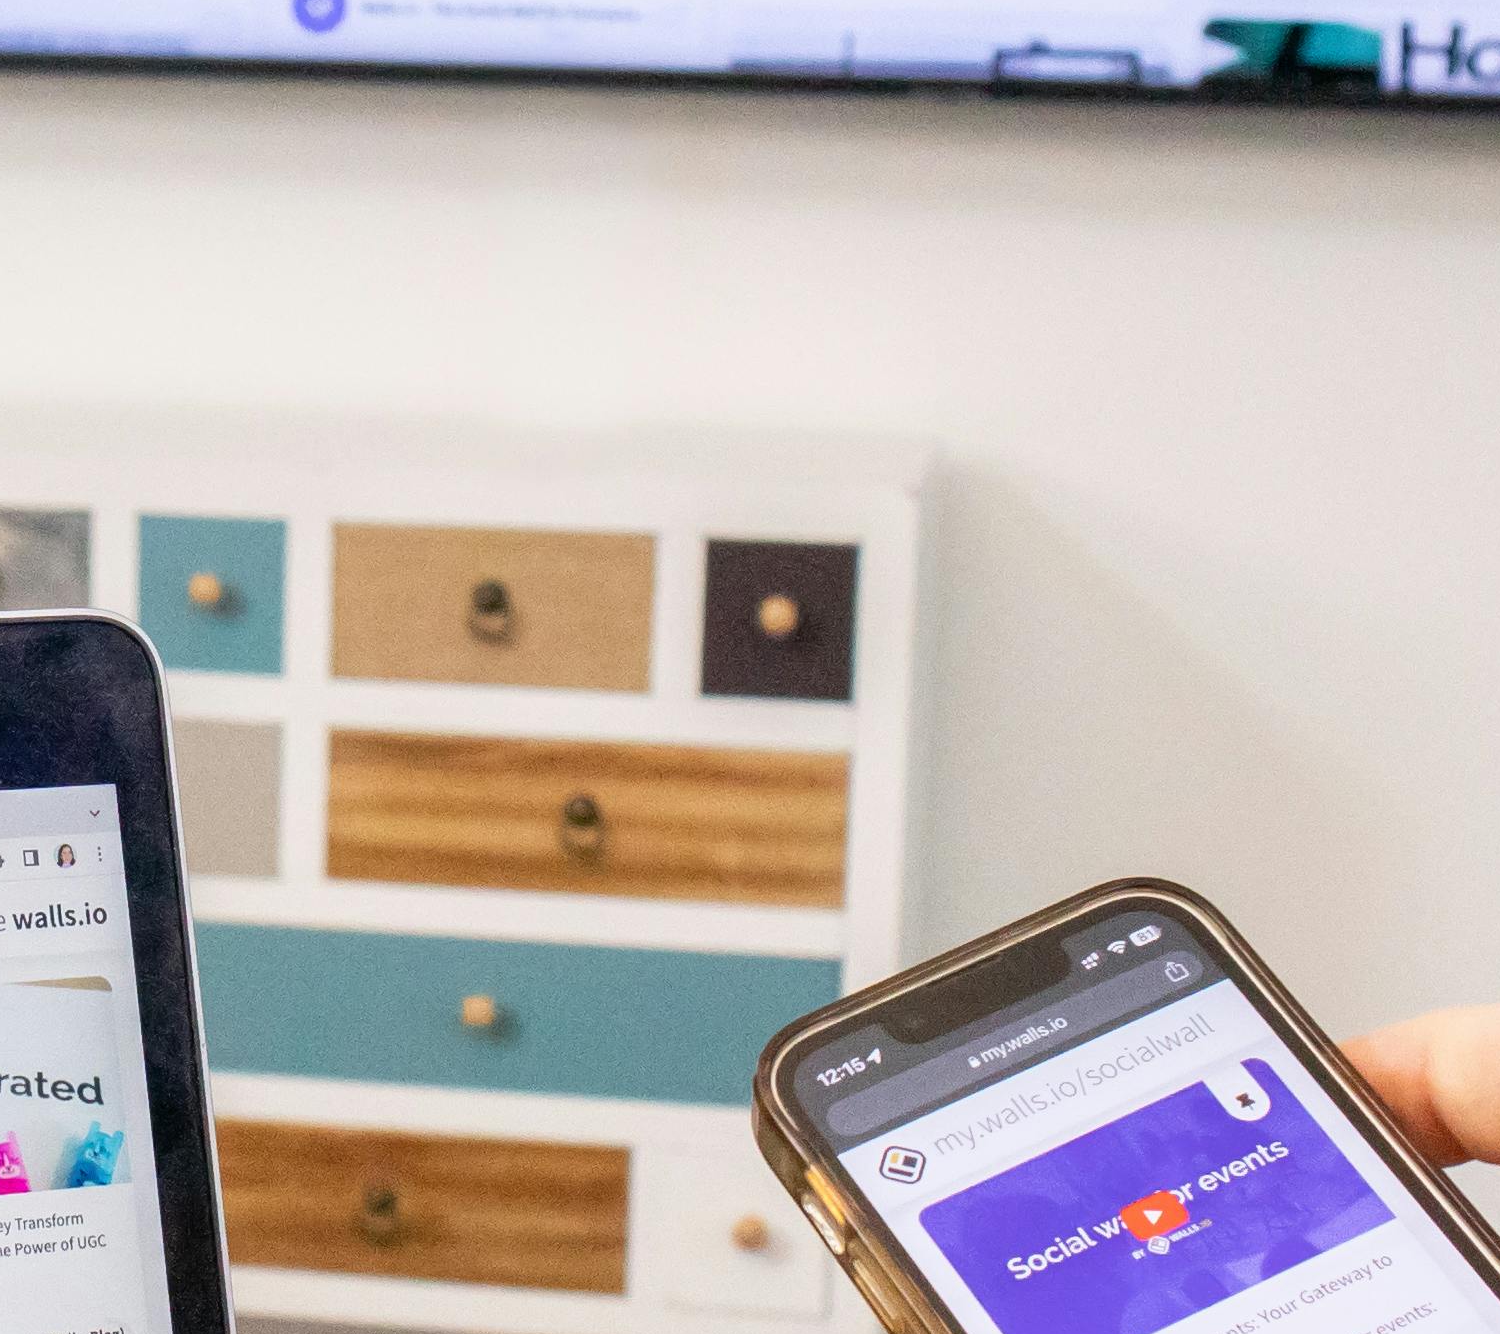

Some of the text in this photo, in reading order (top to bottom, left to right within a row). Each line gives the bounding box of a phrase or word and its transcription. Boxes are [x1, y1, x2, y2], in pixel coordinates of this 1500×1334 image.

[11, 901, 108, 931] walls.io
[980, 1017, 1069, 1065] my.walls.io
[816, 1058, 866, 1087] 12:15
[933, 1012, 1216, 1156] my.walls.io/socialwall
[1007, 1226, 1098, 1280] Social
[1198, 1140, 1289, 1192] events
[1256, 1299, 1299, 1324] Your
[1298, 1264, 1373, 1305] Gateway
[1371, 1255, 1393, 1271] to
